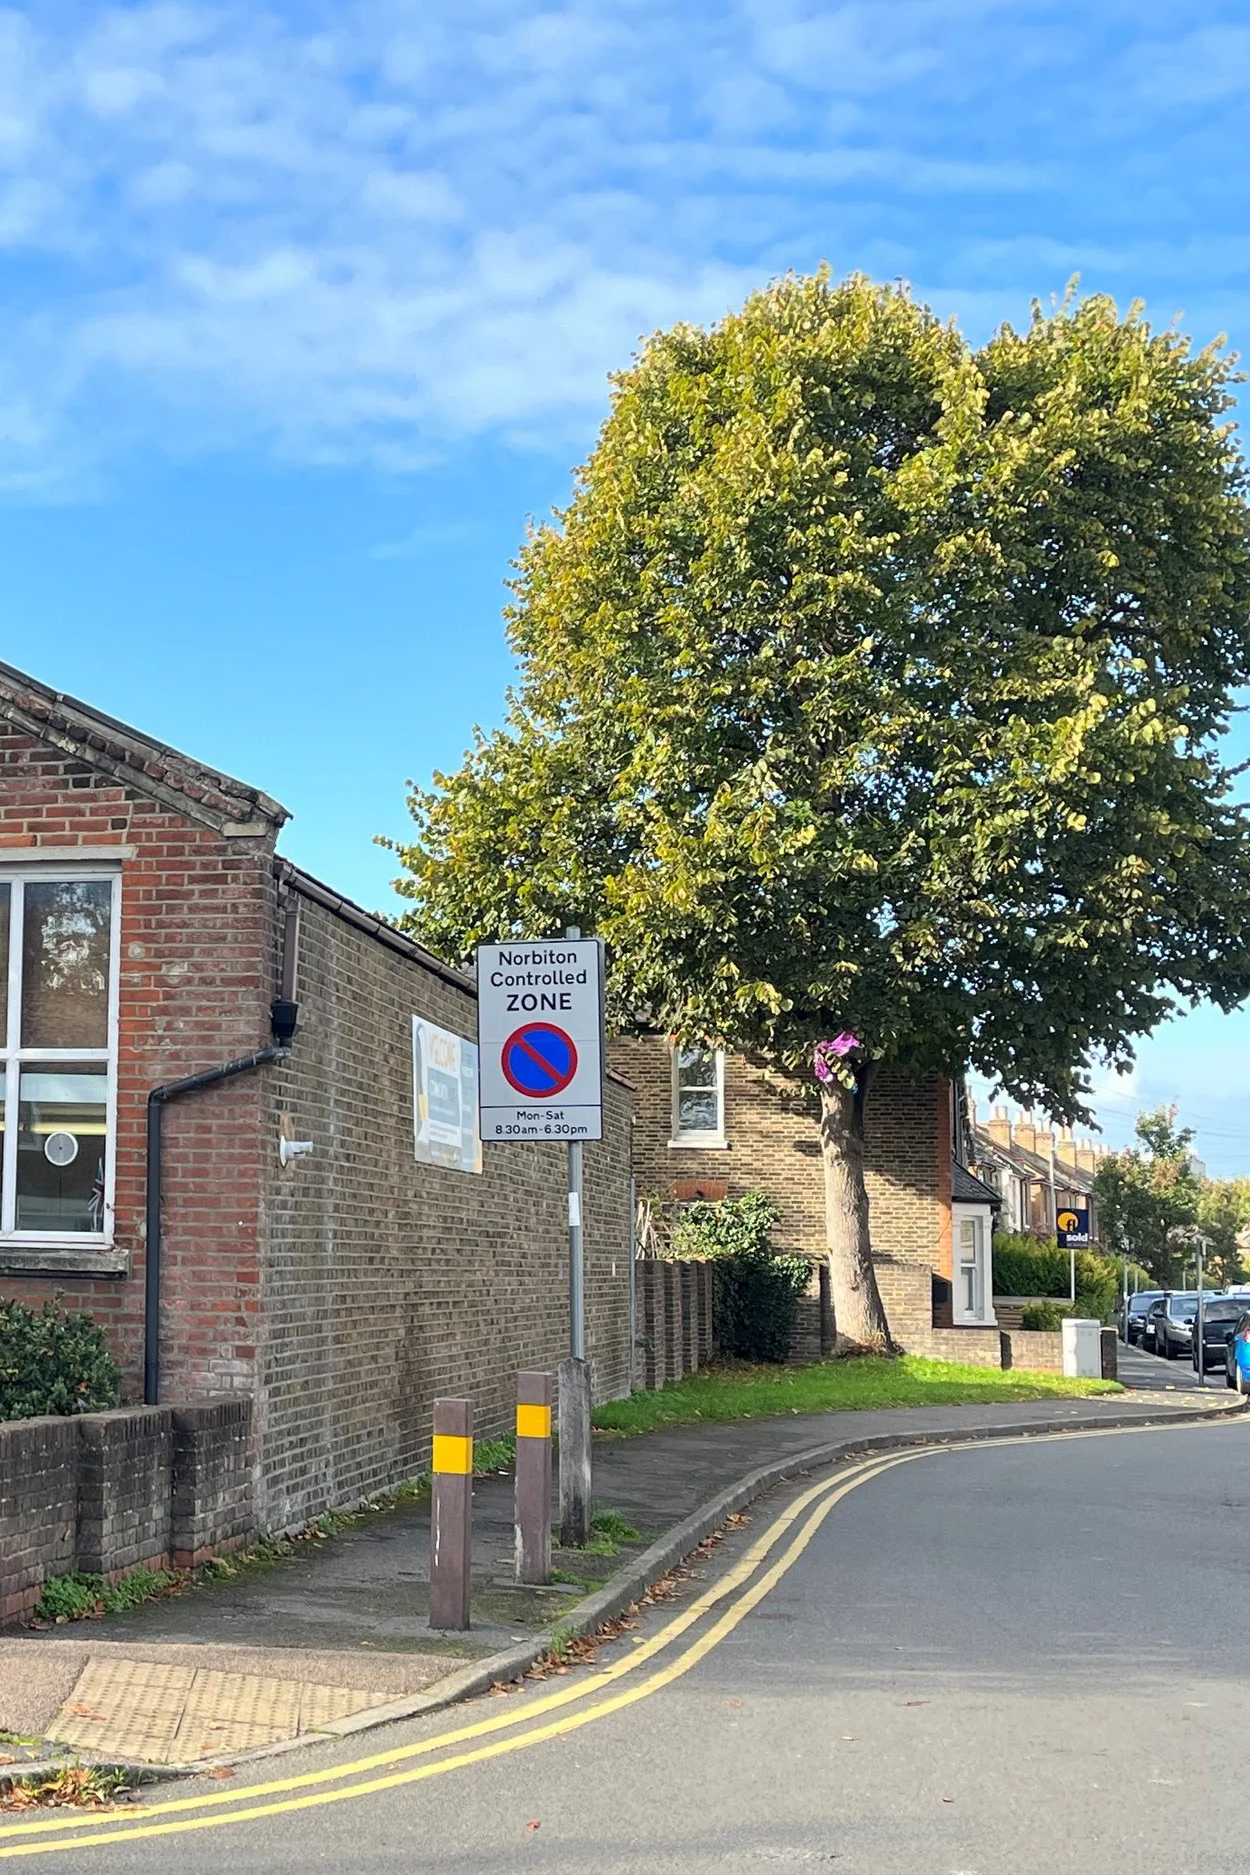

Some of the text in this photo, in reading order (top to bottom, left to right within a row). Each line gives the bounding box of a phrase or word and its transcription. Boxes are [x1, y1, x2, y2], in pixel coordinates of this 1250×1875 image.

[498, 950, 578, 966] Norbiton
[490, 969, 588, 987] Controlled
[506, 992, 573, 1012] ZONE
[516, 1110, 565, 1121] Mon-Sat
[1066, 1233, 1088, 1242] sold
